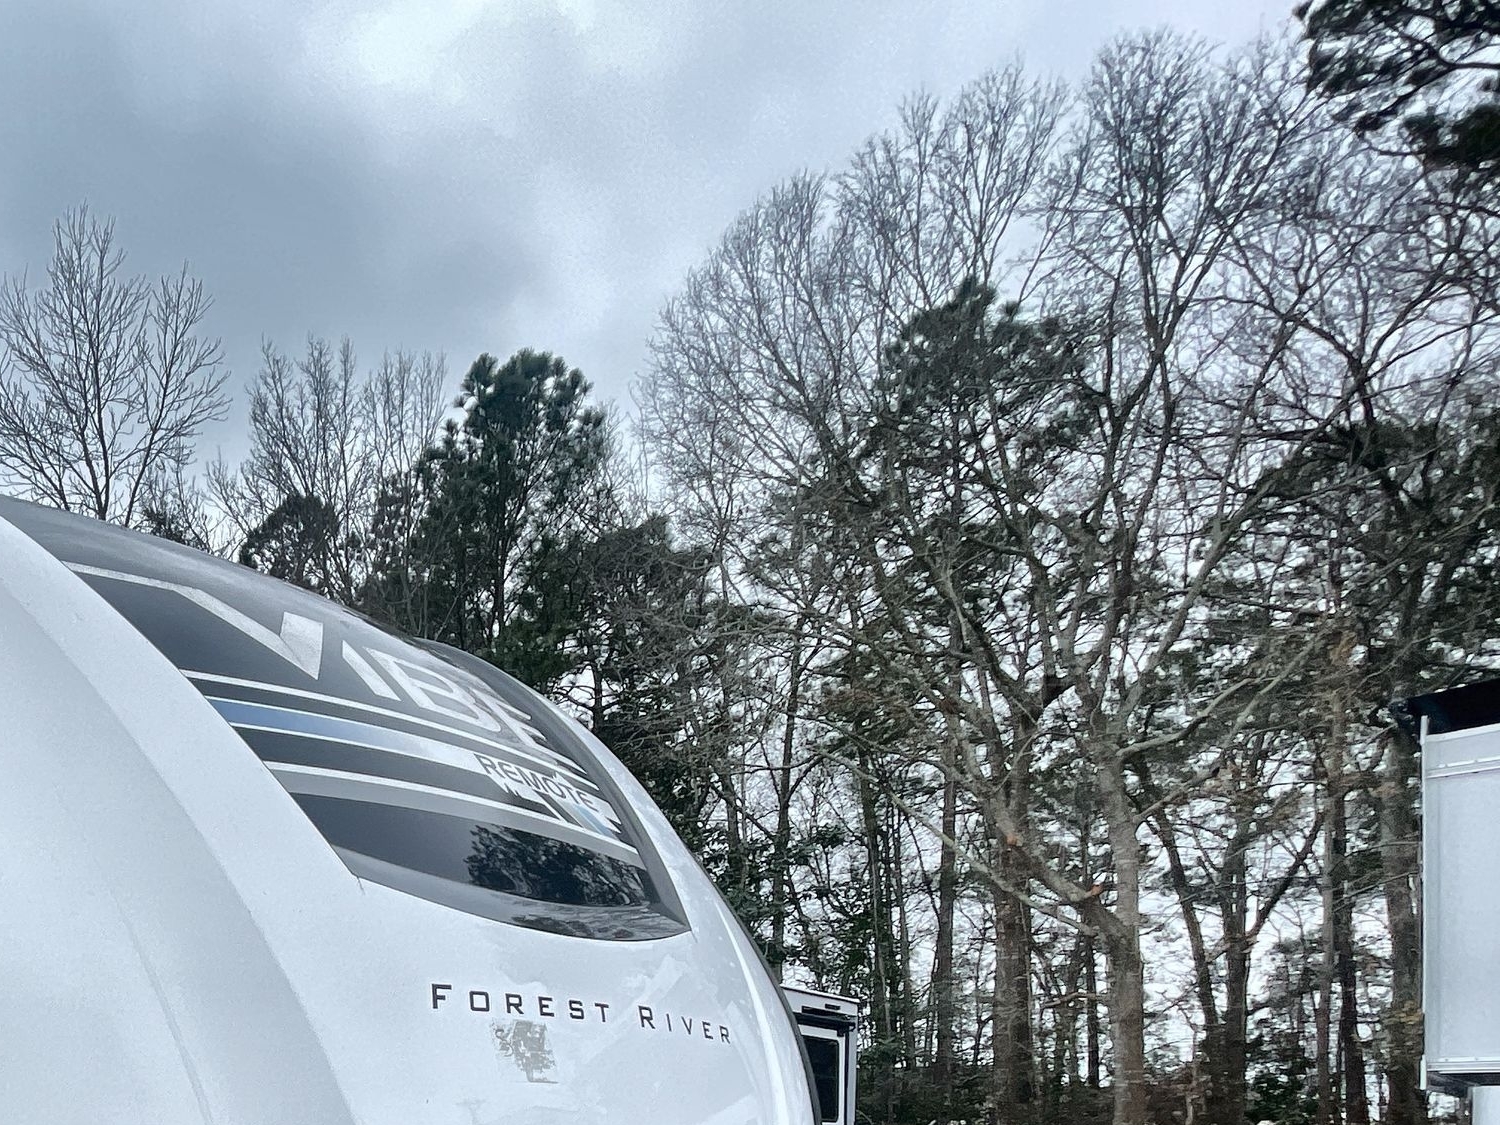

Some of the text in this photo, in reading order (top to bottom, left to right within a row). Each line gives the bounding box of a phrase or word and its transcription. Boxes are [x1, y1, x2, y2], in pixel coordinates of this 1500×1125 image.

[170, 586, 589, 776] VIBE
[473, 753, 599, 812] REMOTE
[431, 983, 731, 1045] FOREST RIVER
